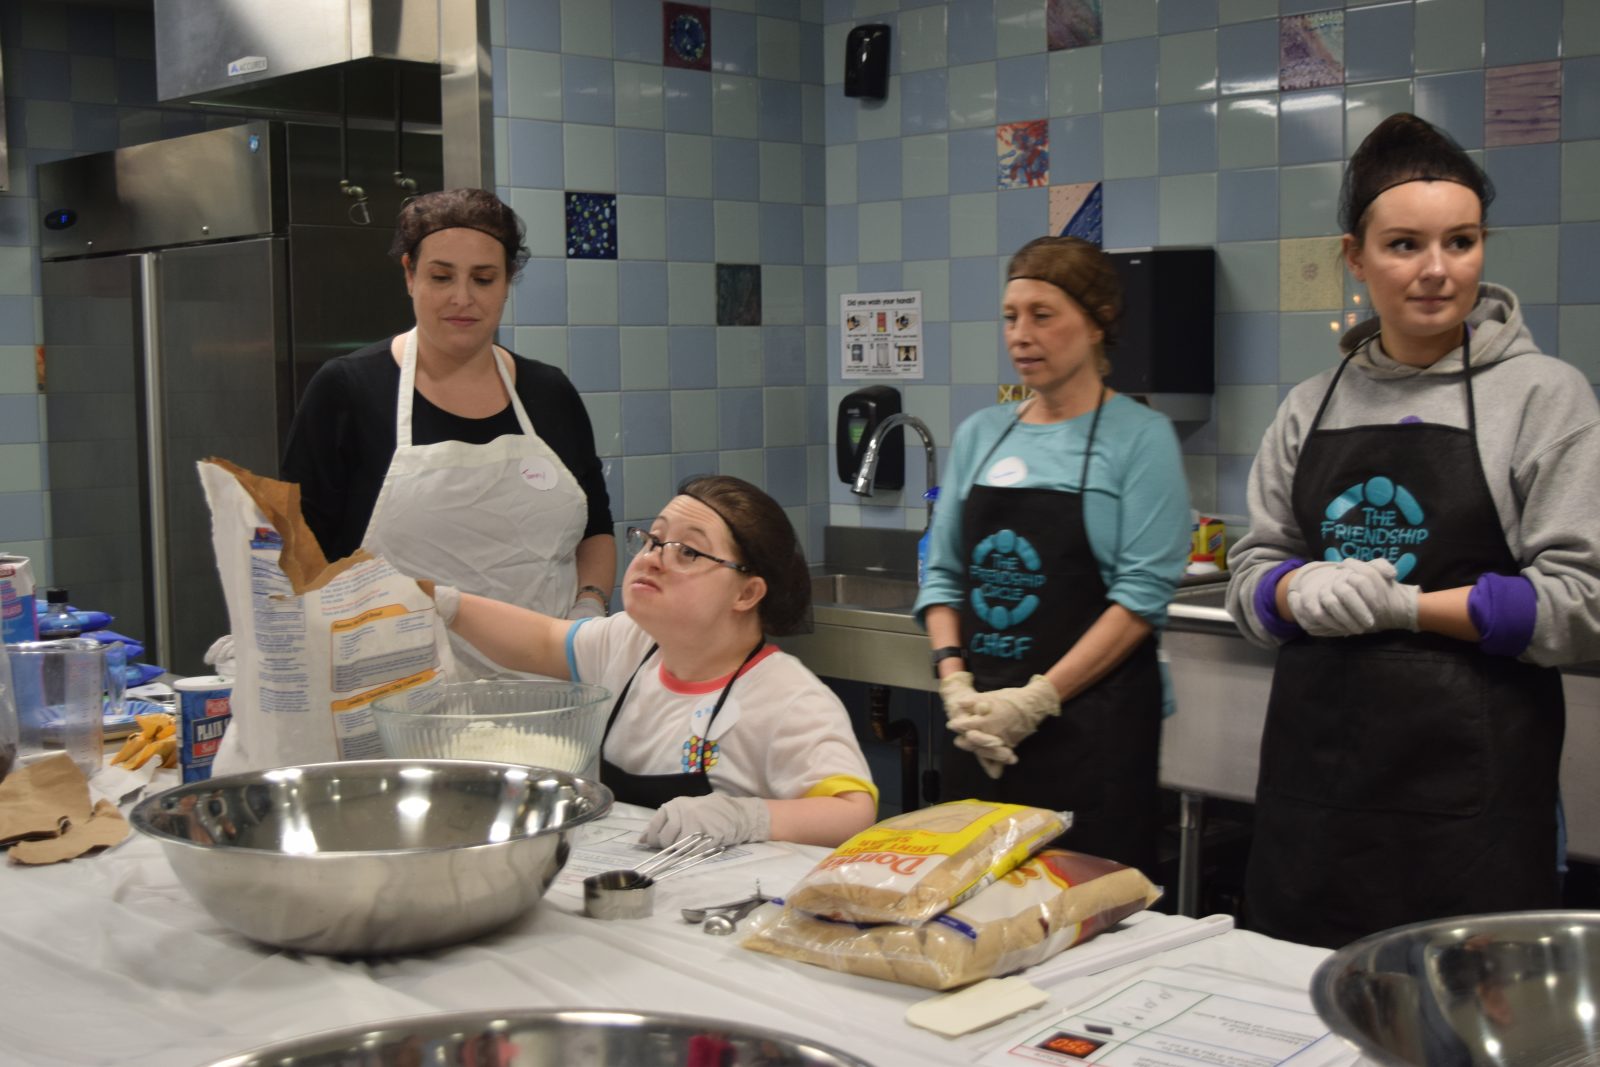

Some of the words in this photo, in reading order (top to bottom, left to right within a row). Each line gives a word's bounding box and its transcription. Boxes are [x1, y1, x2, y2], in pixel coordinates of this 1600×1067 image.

[847, 299, 857, 307] Did
[883, 298, 895, 306] your
[1361, 507, 1397, 526] THE
[1321, 521, 1429, 545] FRIENDSHIP
[991, 553, 1019, 570] THE
[969, 565, 1047, 588] FRIENDSHIP
[970, 632, 1032, 659] CHEF
